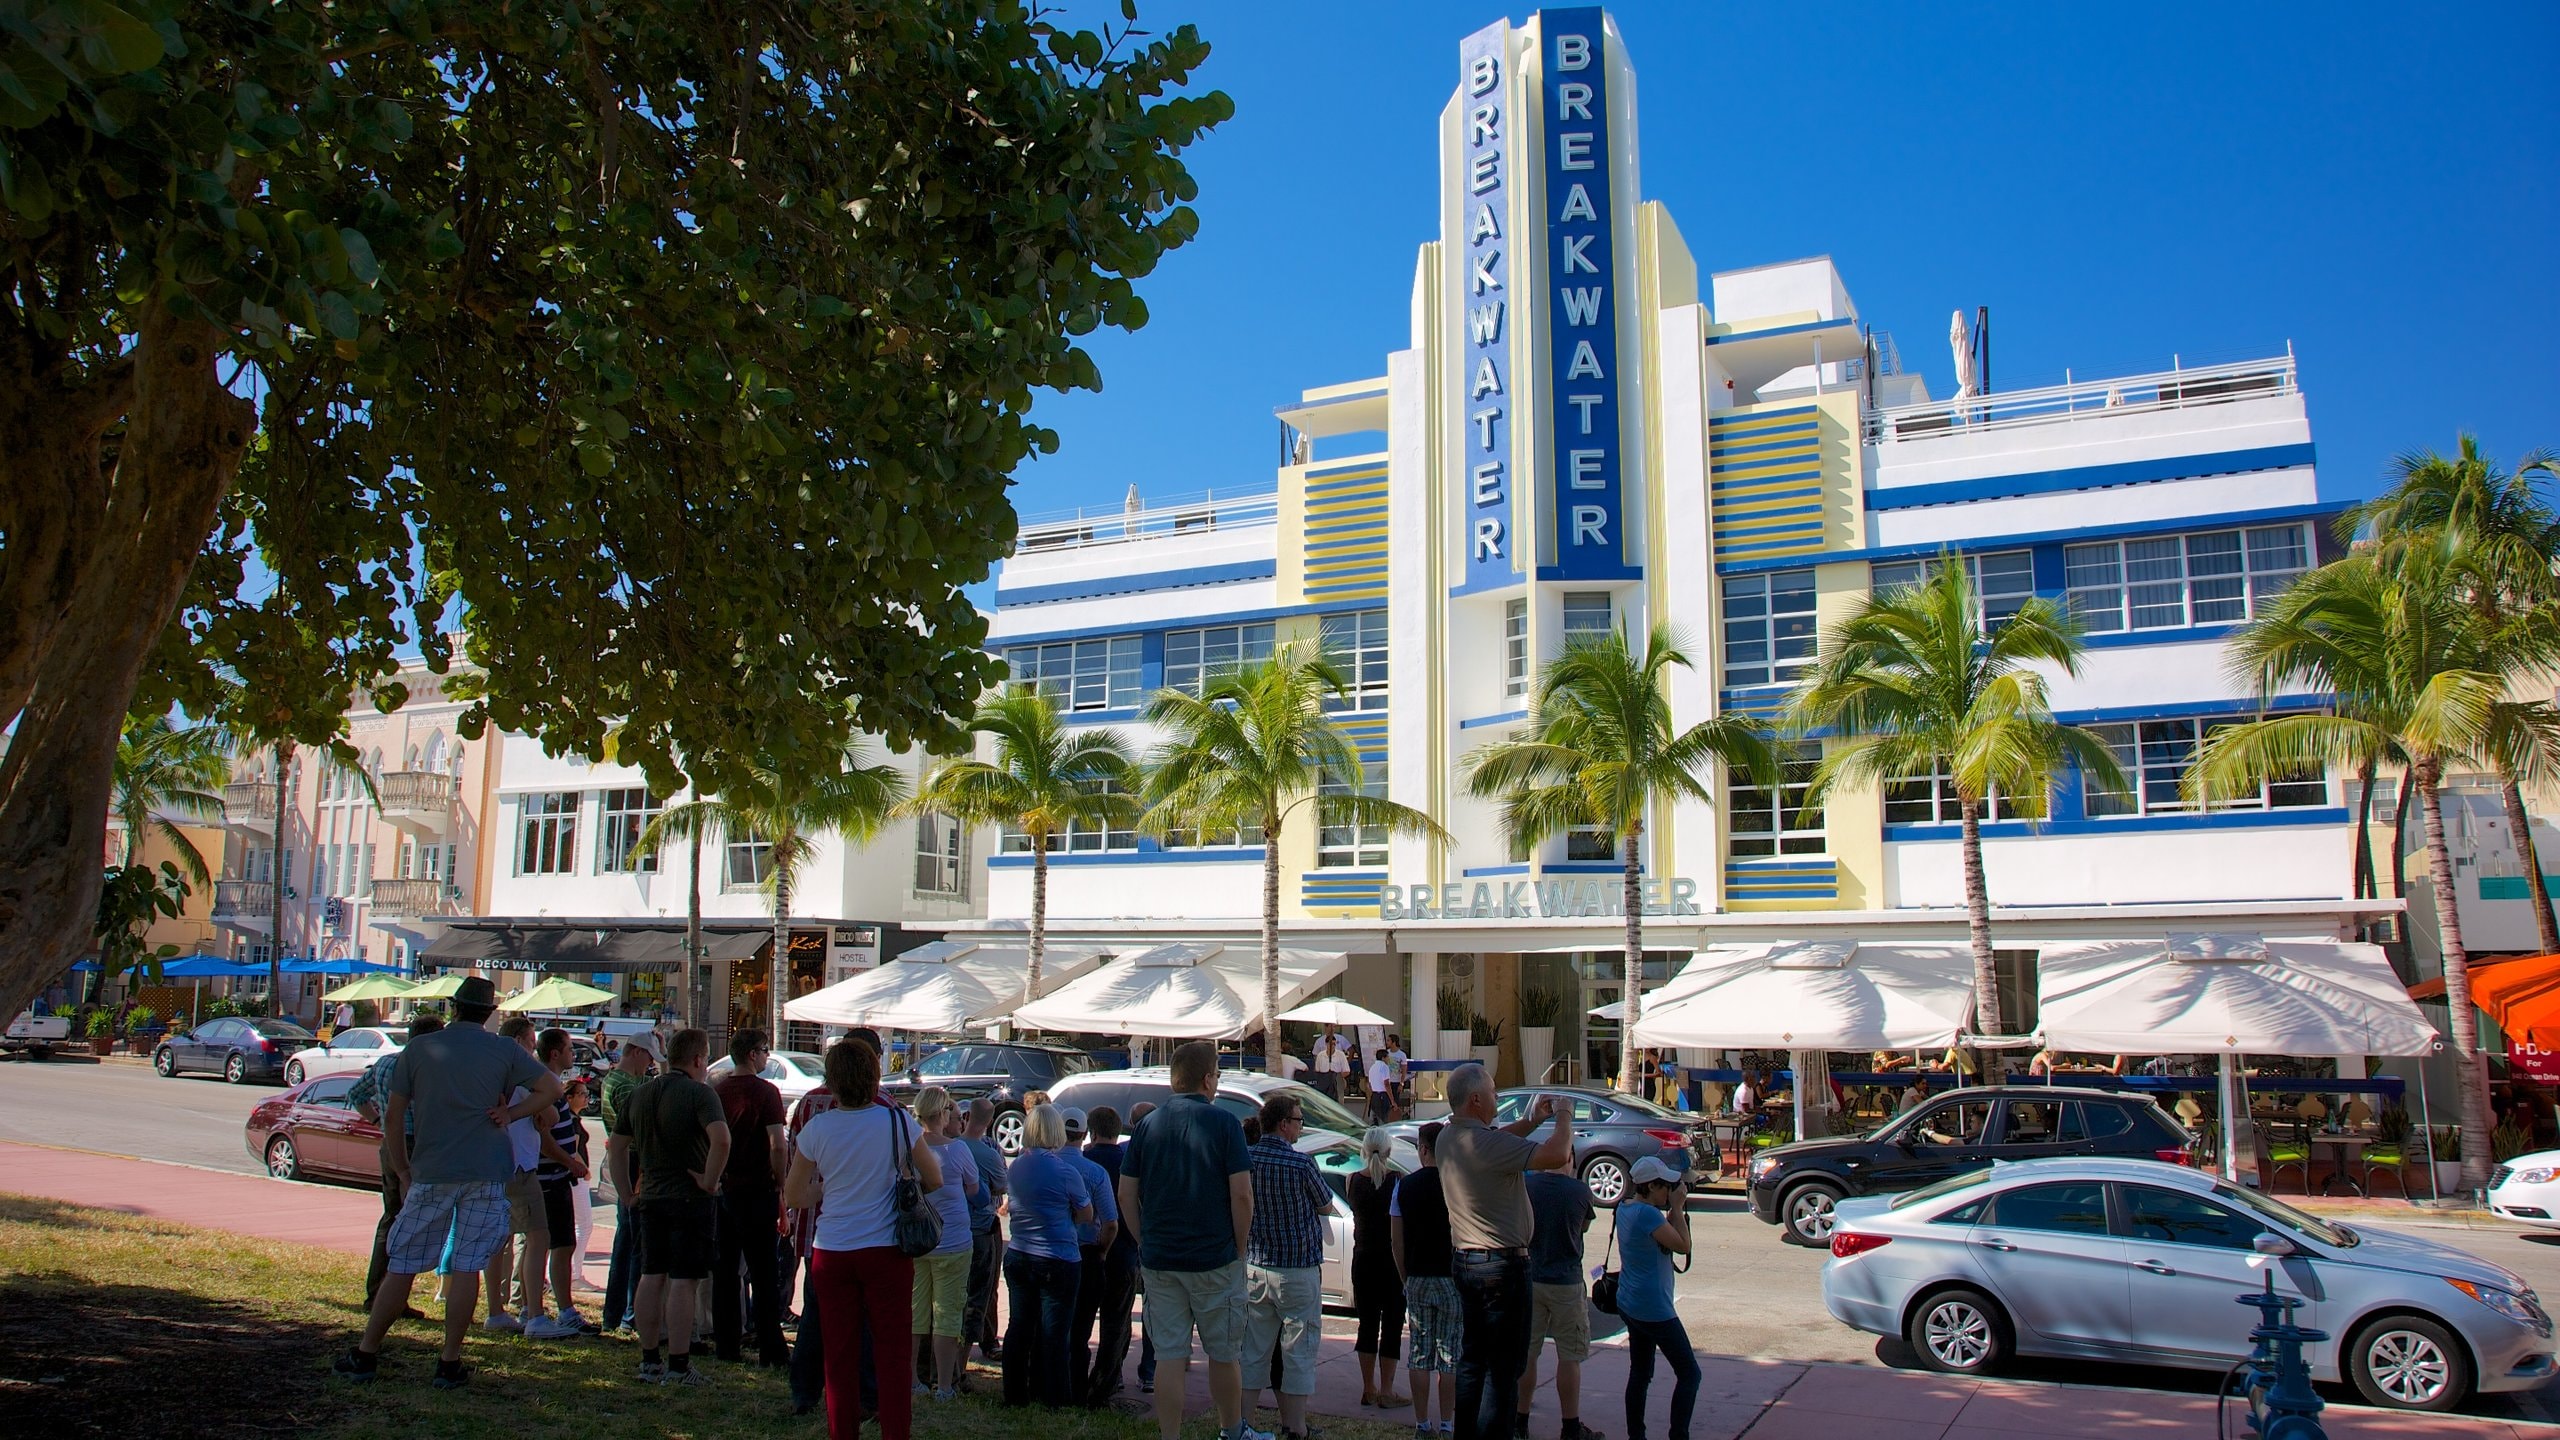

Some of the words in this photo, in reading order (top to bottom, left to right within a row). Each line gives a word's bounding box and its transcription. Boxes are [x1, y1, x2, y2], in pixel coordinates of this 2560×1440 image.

[1556, 34, 1609, 546] BREAKWATER
[1468, 54, 1505, 563] BREAKWATER
[1380, 877, 1700, 920] BREAKWATER
[839, 953, 868, 963] HOSTEL
[475, 959, 509, 969] DECO
[512, 960, 547, 971] WALK
[2526, 1059, 2542, 1067] For
[2543, 1073, 2560, 1081] Drive
